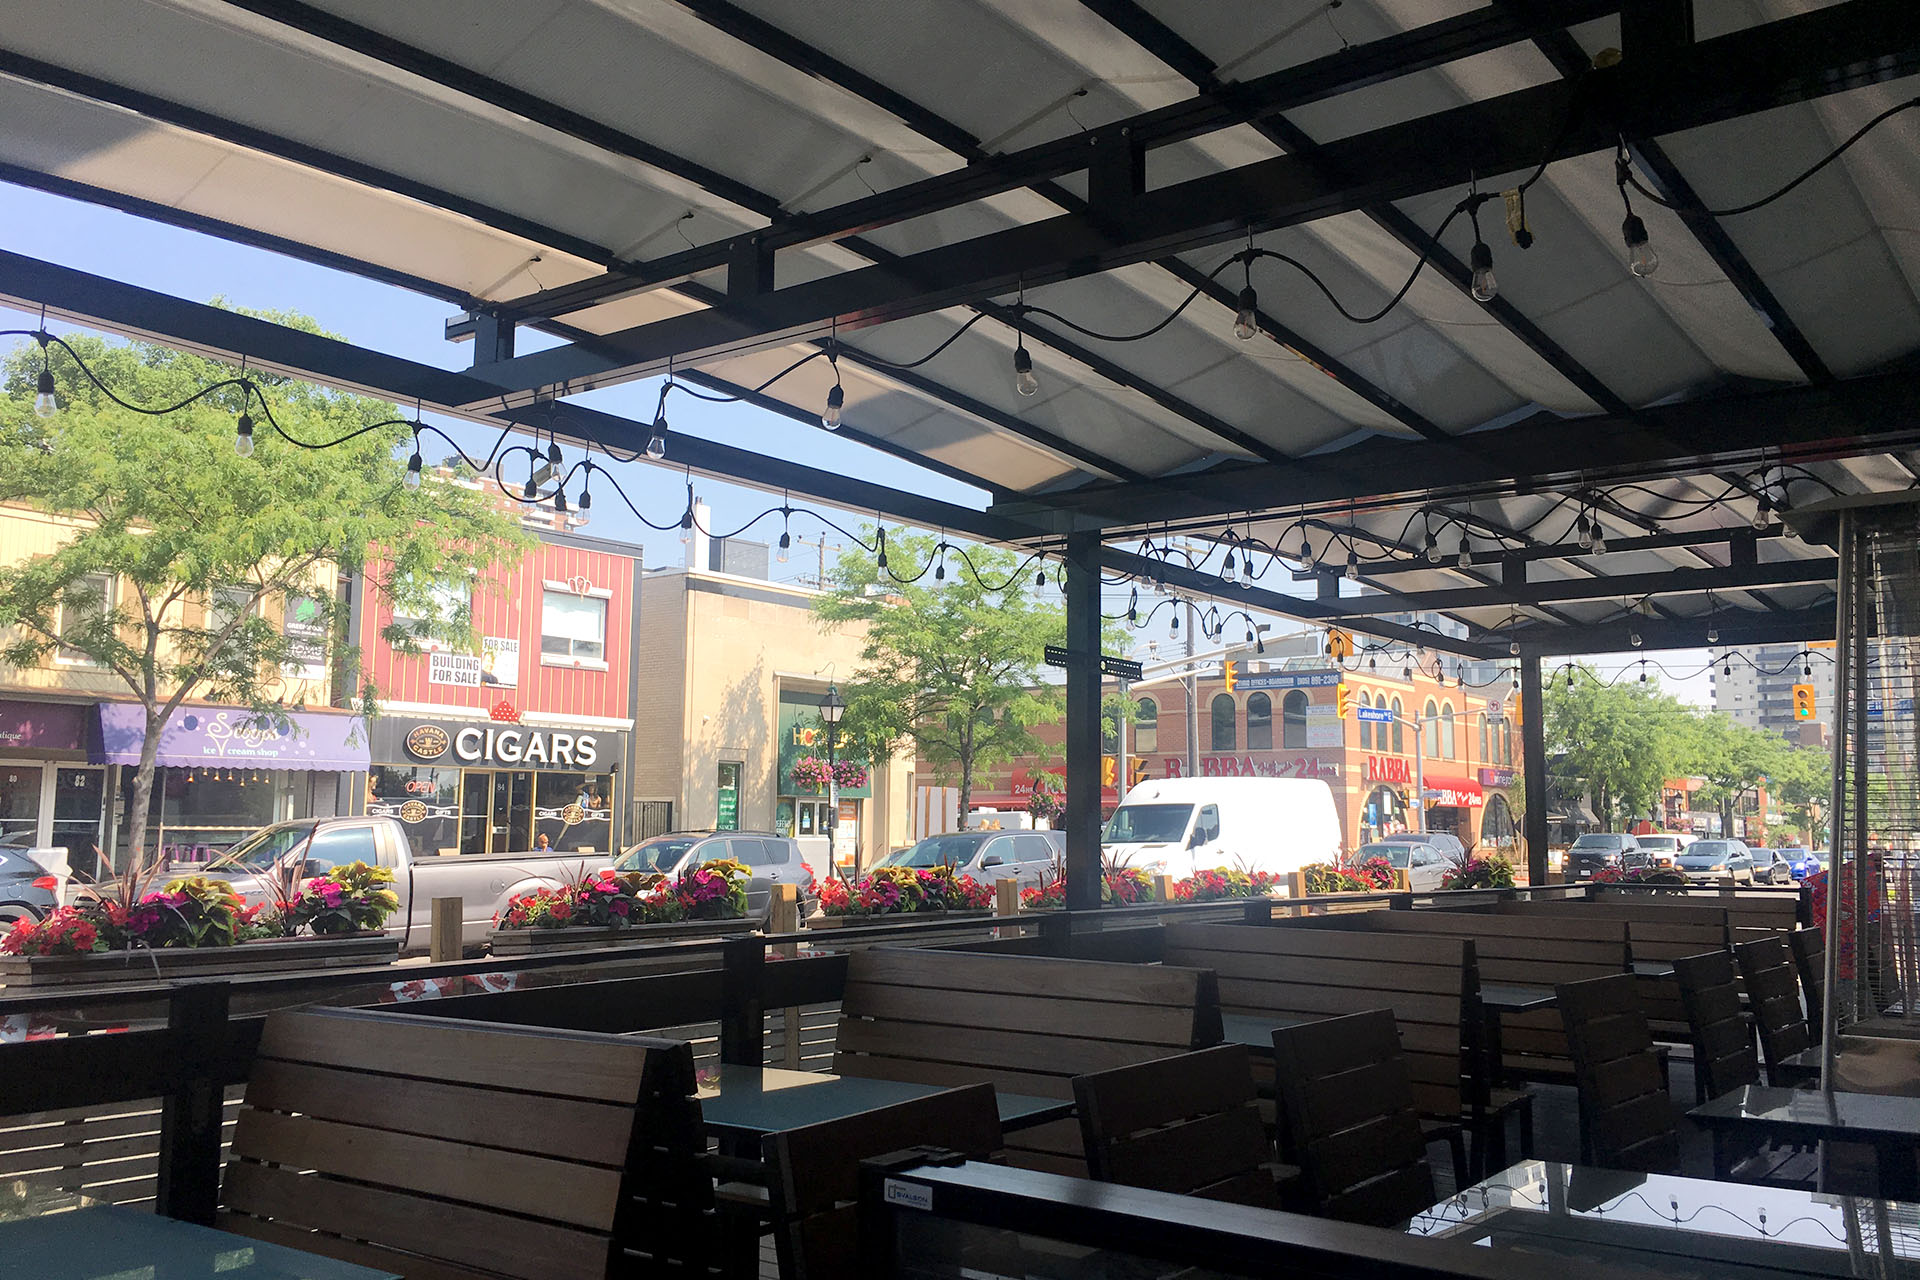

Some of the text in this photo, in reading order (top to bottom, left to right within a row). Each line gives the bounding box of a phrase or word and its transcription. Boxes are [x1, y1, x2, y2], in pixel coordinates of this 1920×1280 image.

[483, 639, 518, 653] FOR SALE
[432, 655, 480, 671] BUILDING
[433, 669, 478, 685] FOR SALE
[1358, 709, 1384, 720] Lakeshore
[412, 727, 445, 738] HAVANA
[227, 748, 256, 757] cream
[257, 747, 279, 757] shop
[412, 744, 444, 755] CASTLE
[454, 726, 598, 767] CIGARS
[1164, 756, 1257, 778] RBBA
[1368, 755, 1412, 784] RABBA
[74, 774, 86, 787] 82
[405, 780, 437, 794] OPEN
